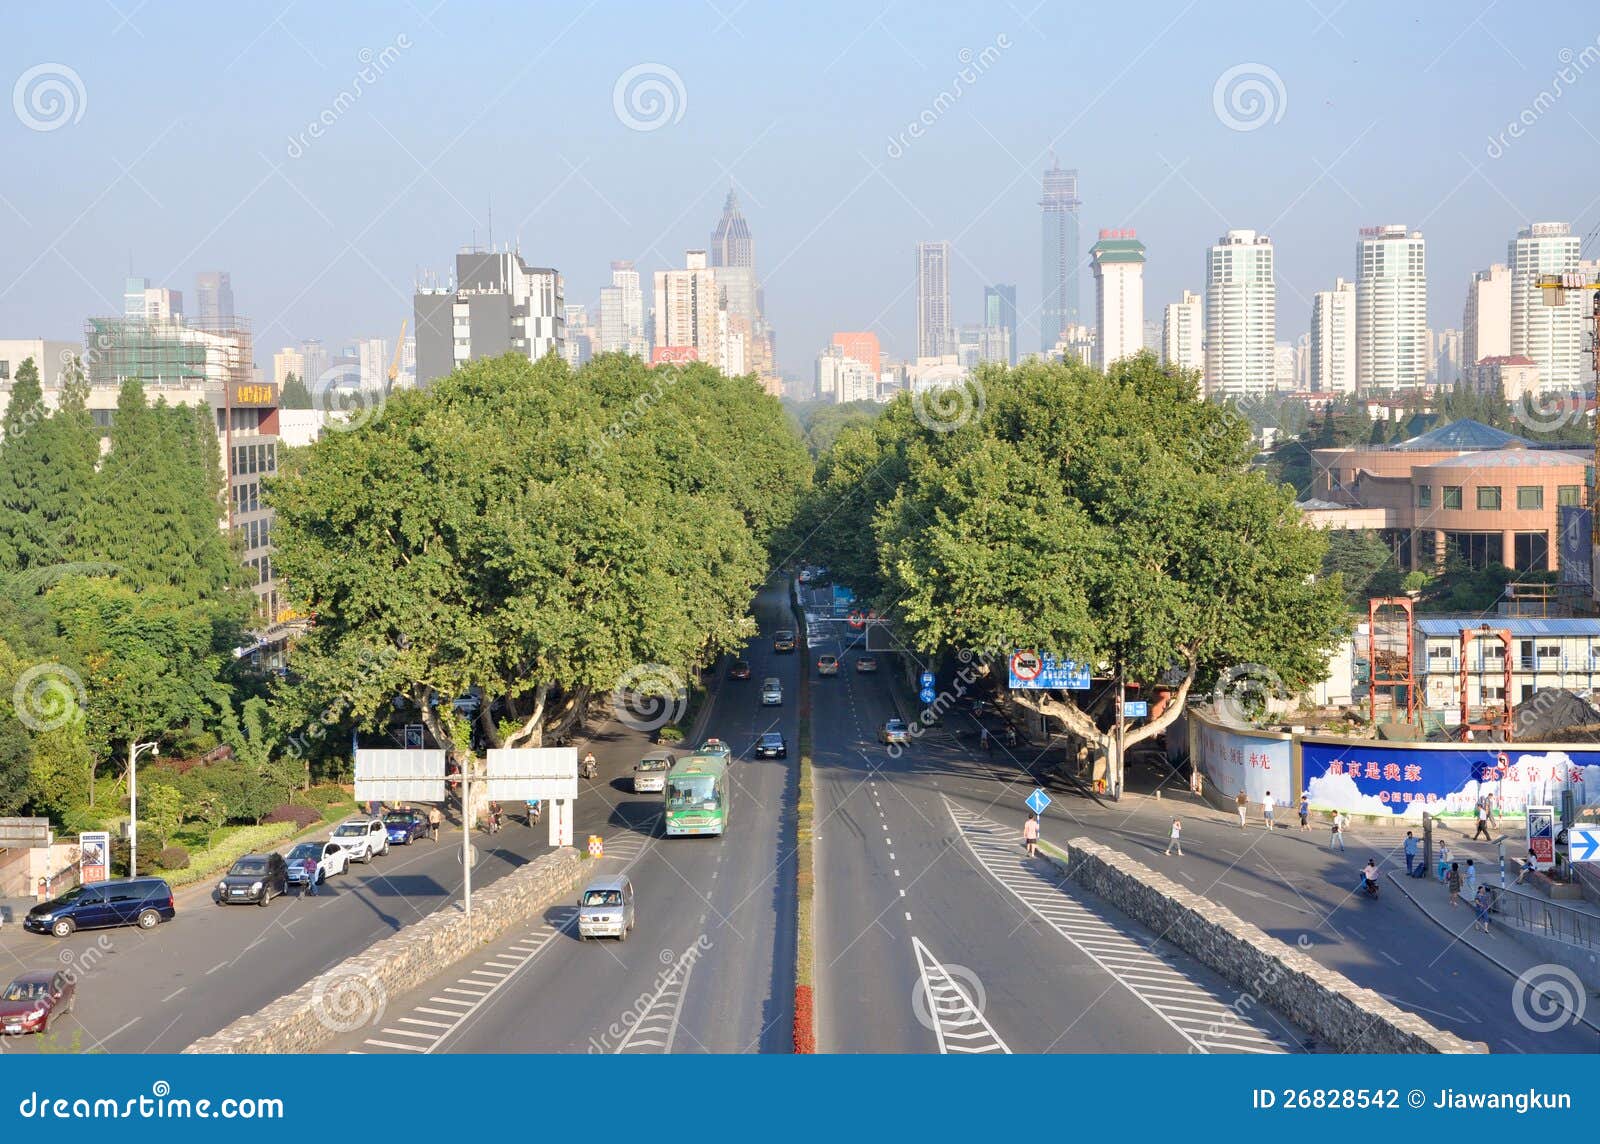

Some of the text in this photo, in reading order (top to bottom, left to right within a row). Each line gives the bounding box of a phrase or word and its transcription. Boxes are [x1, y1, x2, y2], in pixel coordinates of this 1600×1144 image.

[1329, 759, 1422, 782] 南京是我家
